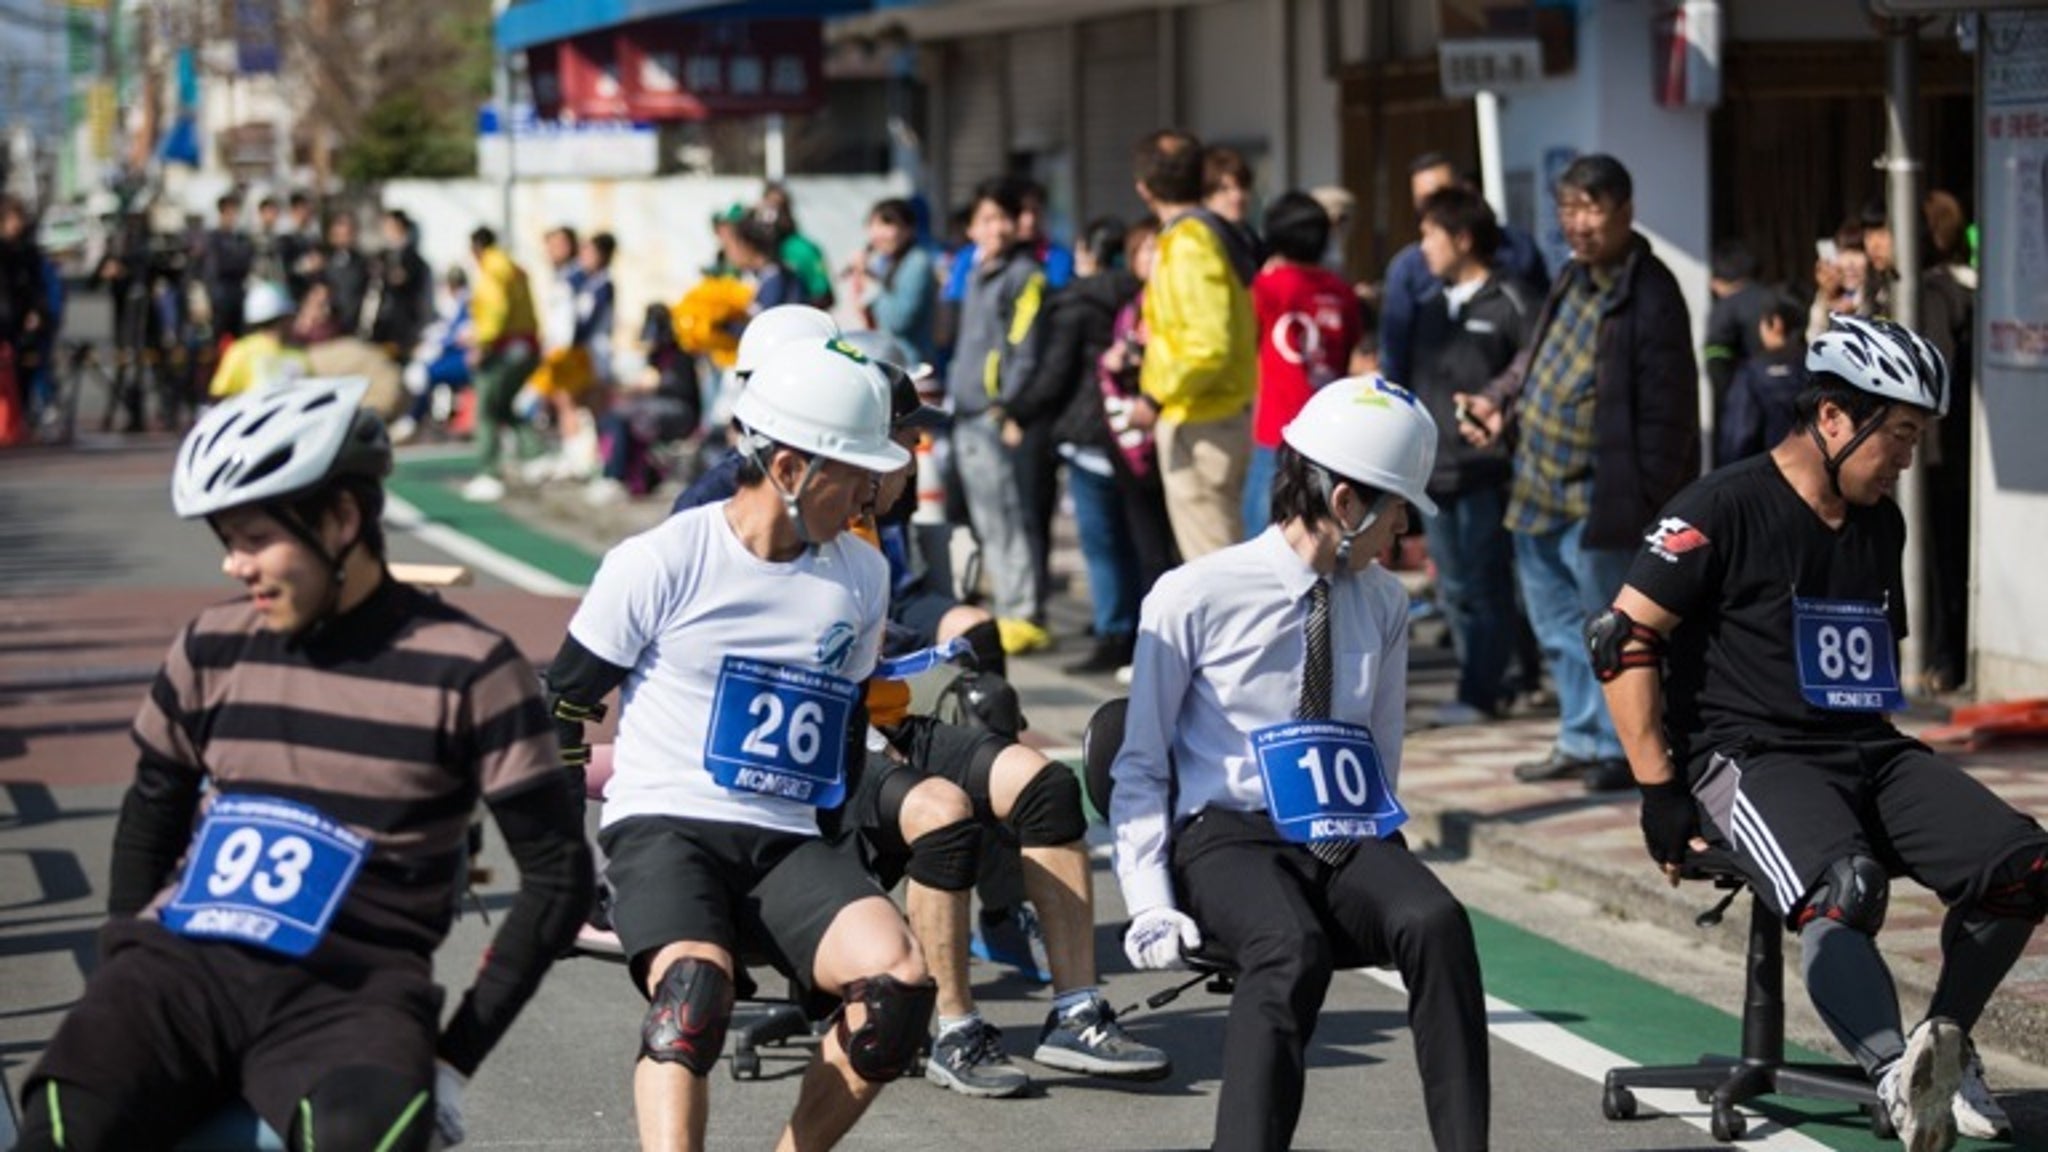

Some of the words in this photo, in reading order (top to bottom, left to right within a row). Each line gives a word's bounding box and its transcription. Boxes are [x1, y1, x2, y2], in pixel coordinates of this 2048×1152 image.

[1818, 625, 1873, 681] 89
[741, 692, 824, 765] 26
[1298, 747, 1367, 806] 10
[208, 827, 313, 904] 93
